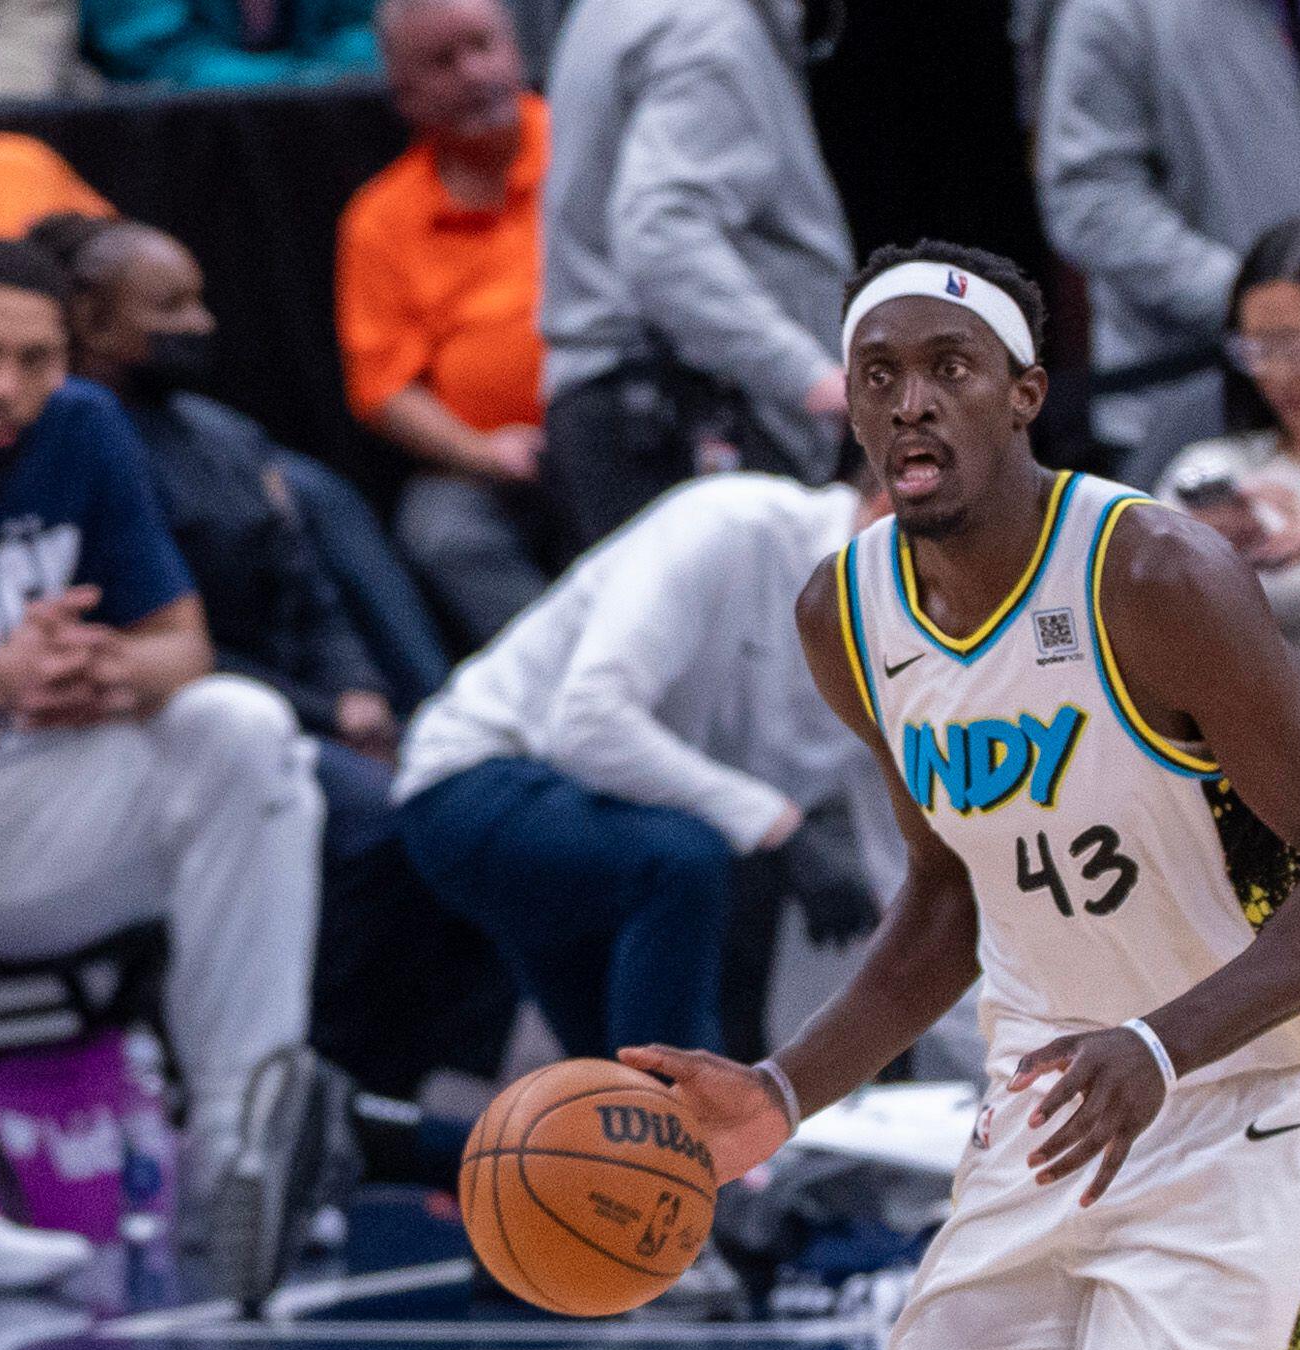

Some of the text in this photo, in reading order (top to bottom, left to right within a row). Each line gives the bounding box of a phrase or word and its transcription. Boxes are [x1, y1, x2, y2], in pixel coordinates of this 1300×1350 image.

[902, 702, 1091, 818] INDY
[1016, 823, 1139, 918] 43
[596, 1105, 714, 1170] Wilso
